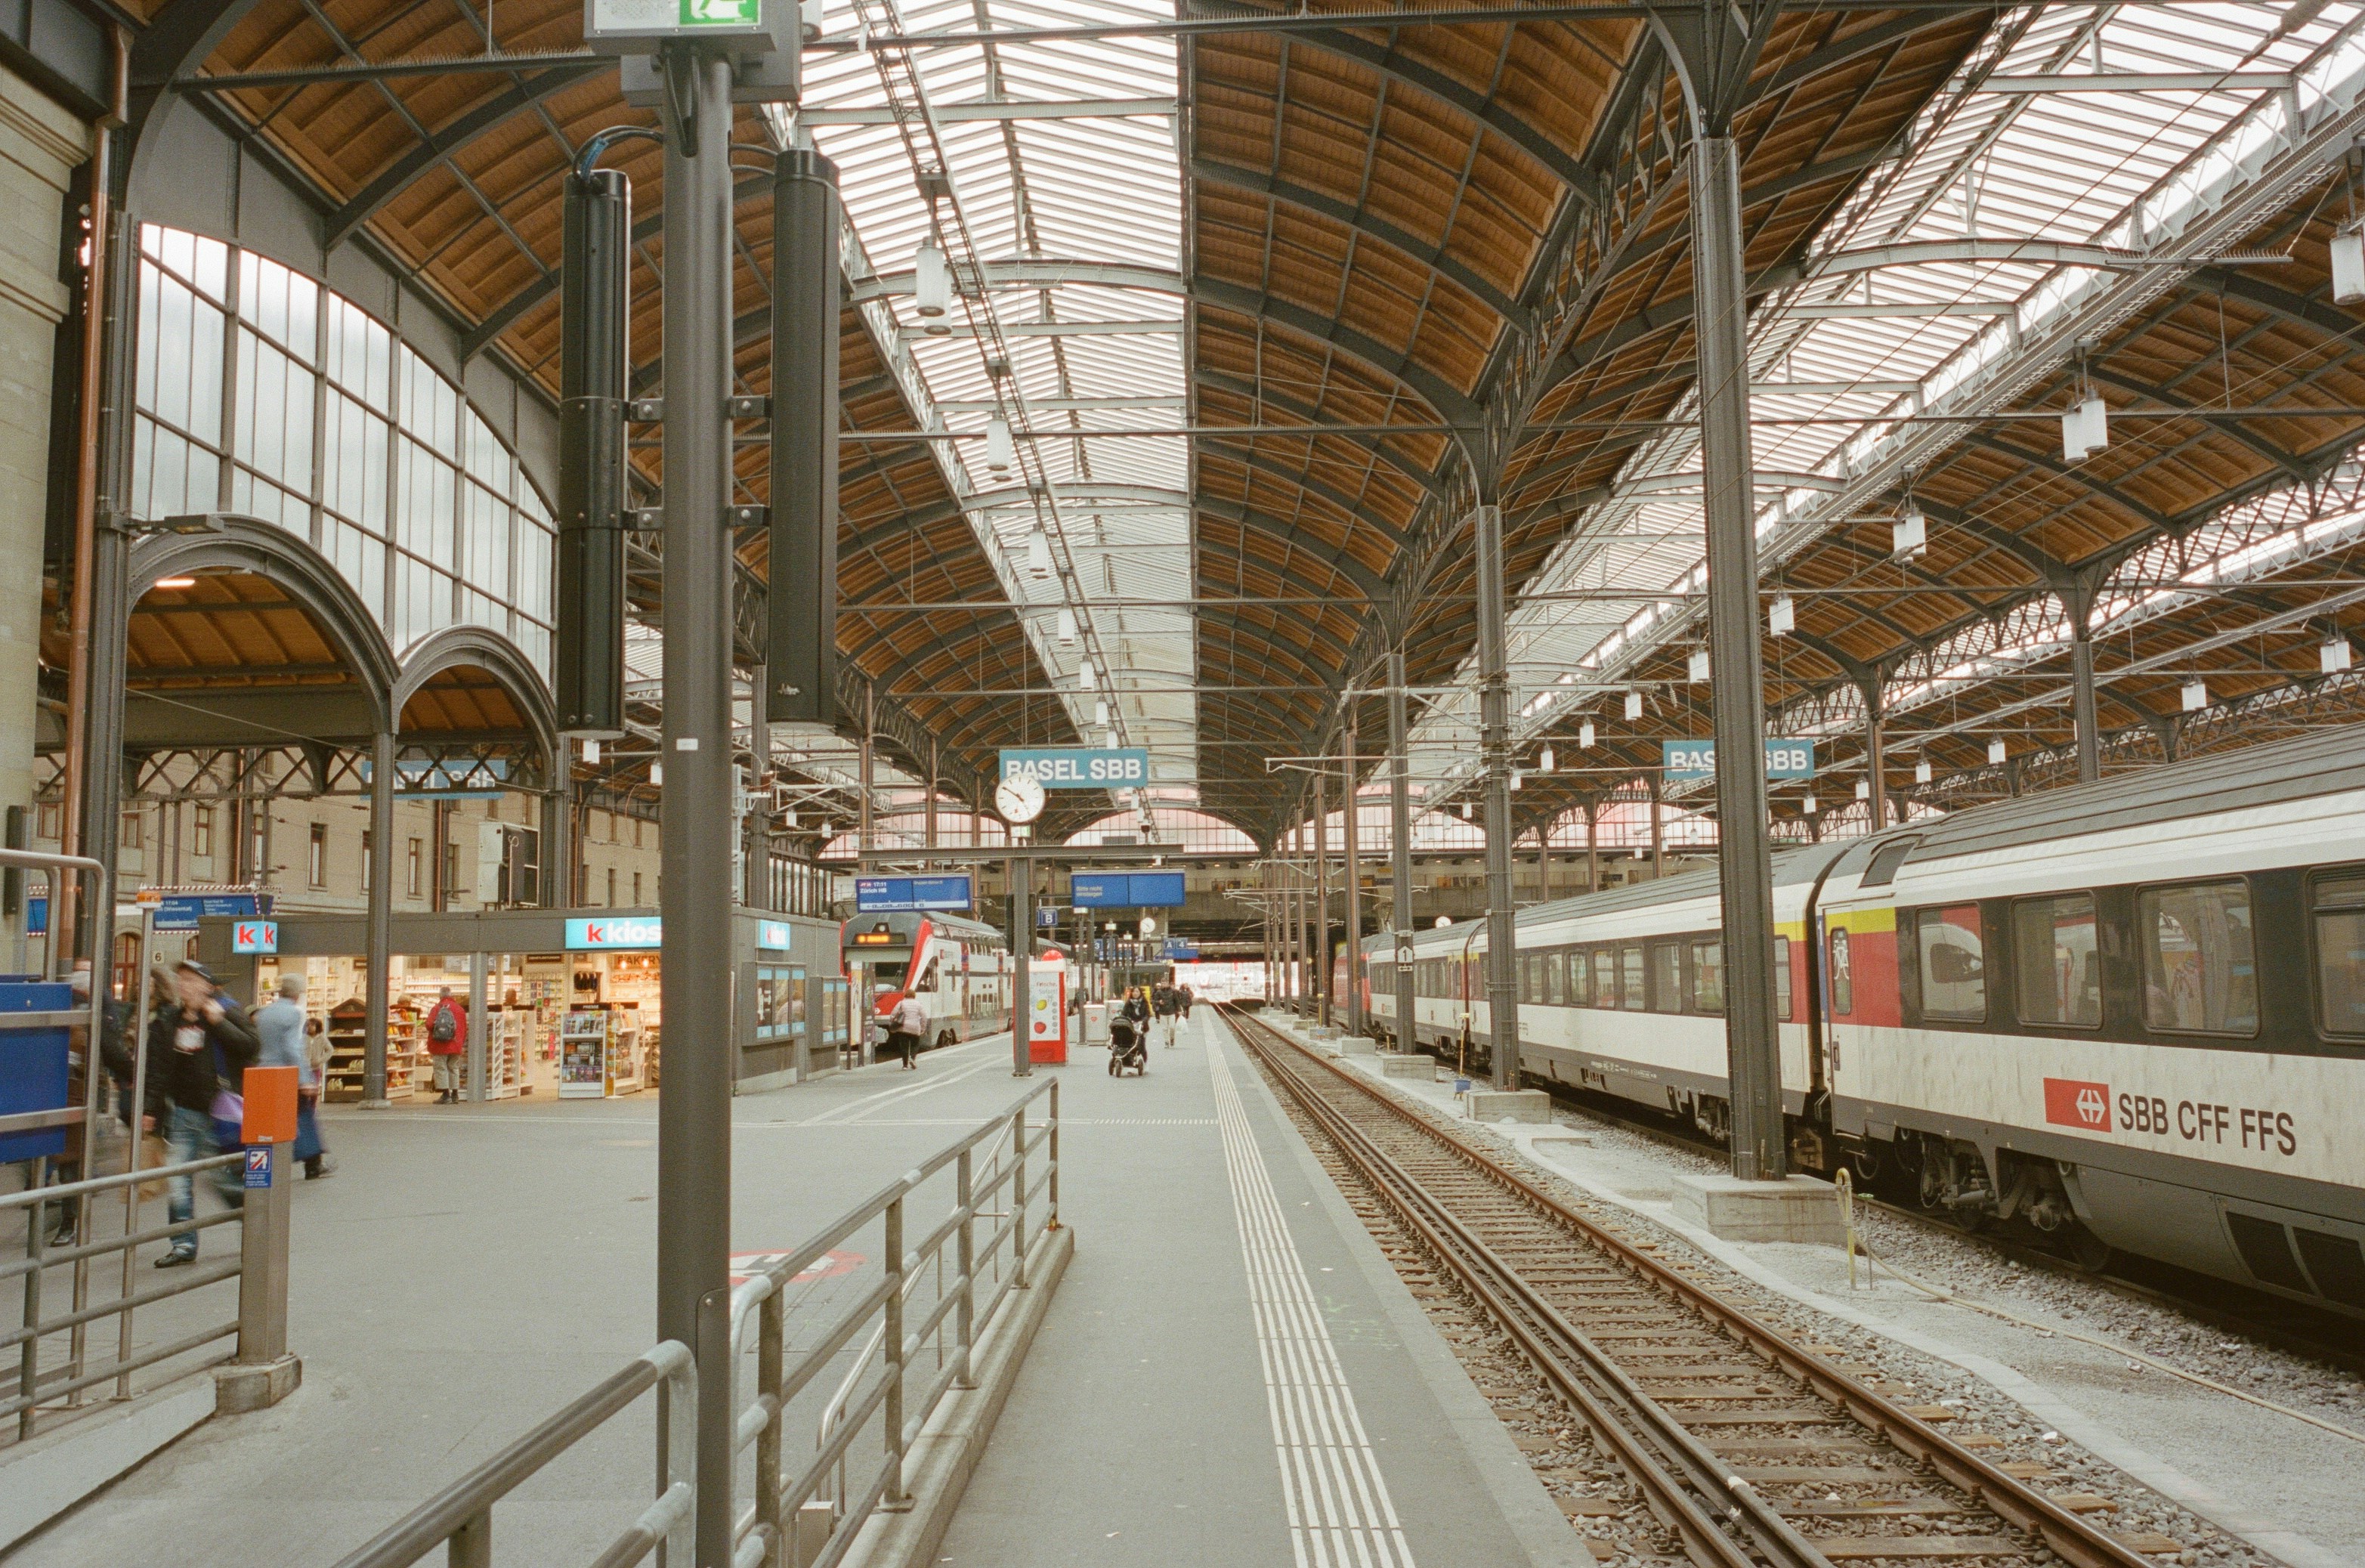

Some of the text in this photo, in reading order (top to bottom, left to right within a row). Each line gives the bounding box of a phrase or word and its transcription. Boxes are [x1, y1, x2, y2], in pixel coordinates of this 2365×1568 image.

[1006, 759, 1142, 781] BASEL SBB
[1670, 750, 1716, 772] BAS
[1045, 914, 1053, 923] B
[238, 924, 255, 944] k
[264, 924, 274, 944] k
[587, 920, 662, 943] k kios
[1817, 920, 1822, 946] 1
[154, 952, 162, 962] 6
[1402, 949, 1407, 962] 1
[2119, 1093, 2296, 1156] SBB CFF FFS
